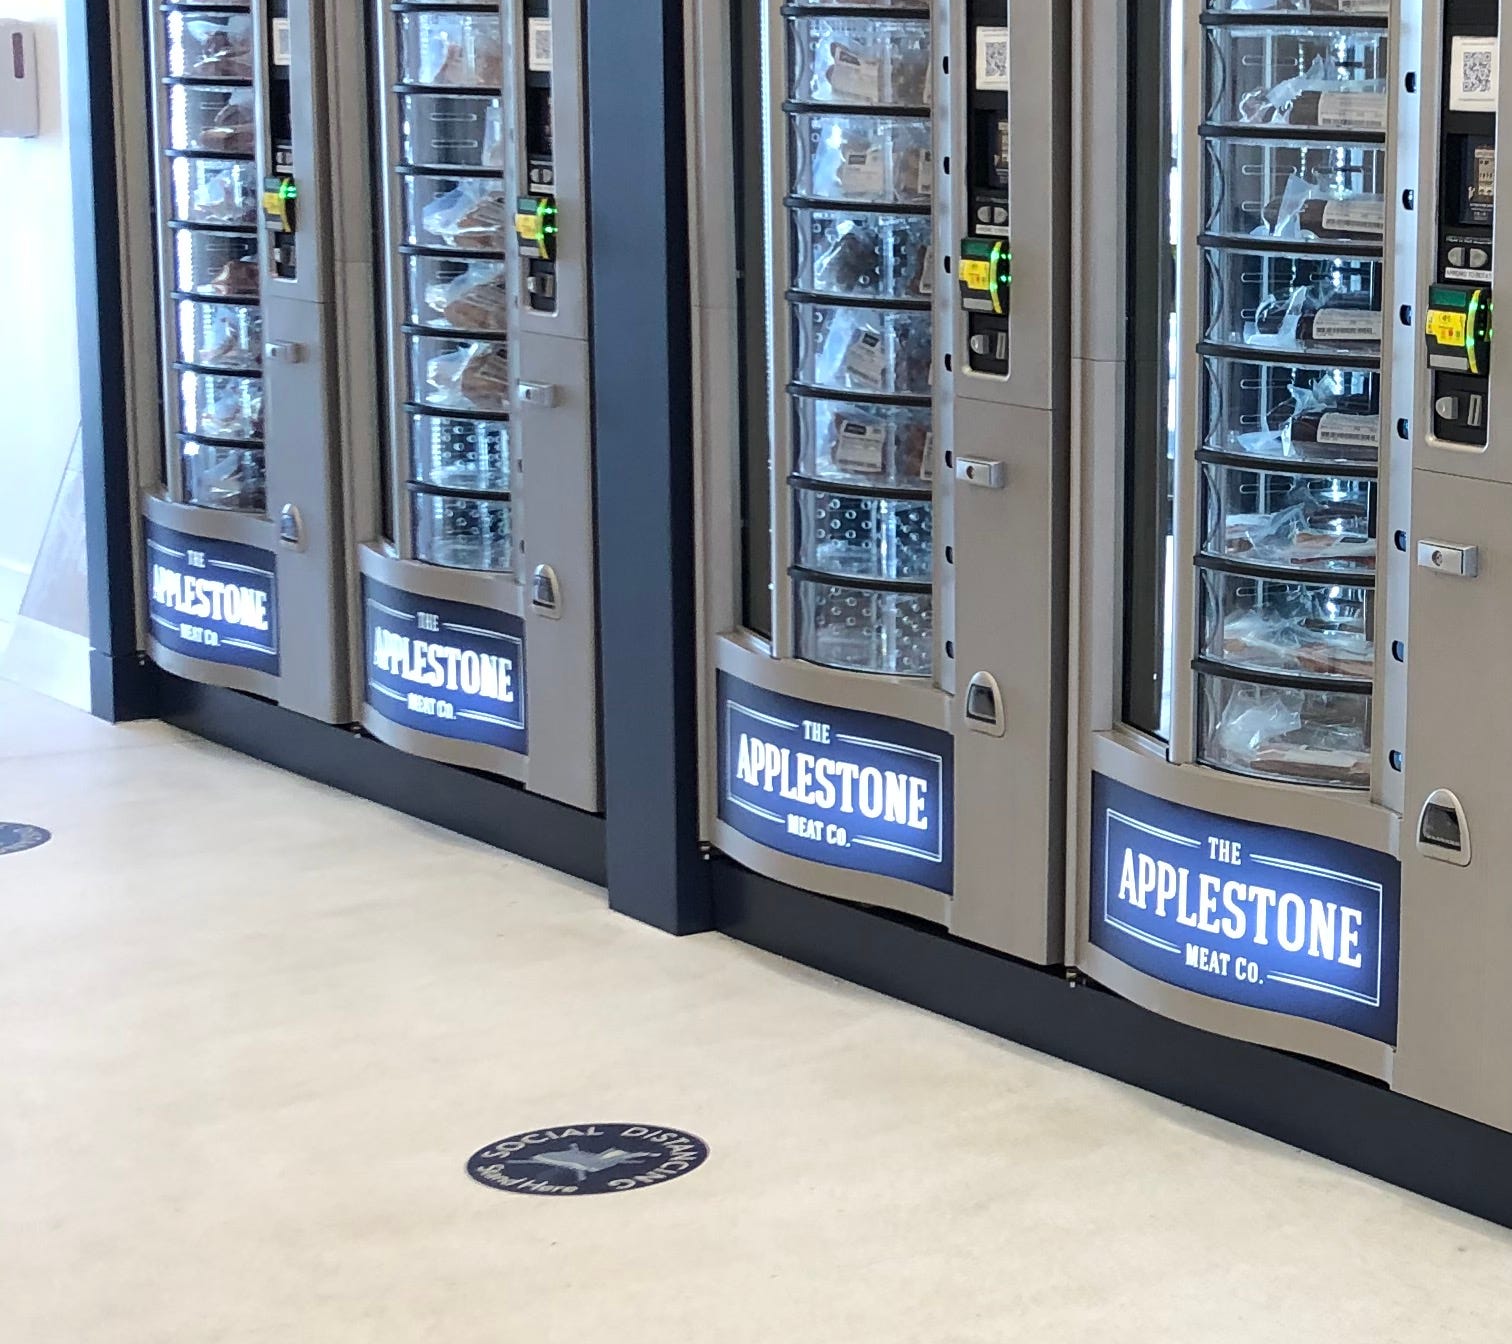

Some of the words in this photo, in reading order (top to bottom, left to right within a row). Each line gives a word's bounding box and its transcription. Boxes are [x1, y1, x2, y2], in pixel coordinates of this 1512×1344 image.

[186, 550, 206, 568] THE
[152, 564, 268, 630] APPLESTONE
[417, 611, 440, 632] THE
[374, 626, 514, 702] APPLESTONE
[408, 692, 436, 715] MEAT
[802, 720, 830, 744] THE
[737, 733, 928, 830] APPLESTONE
[787, 813, 823, 840] MEAT
[826, 824, 851, 847] CO.
[1208, 836, 1241, 865] THE
[1118, 847, 1363, 968] APPLESTONE
[1185, 943, 1231, 975] MEAT
[1235, 958, 1264, 984] CO.
[481, 1126, 604, 1160] SOCIAL
[608, 1126, 699, 1190] DISTANCING
[522, 1178, 578, 1193] Here
